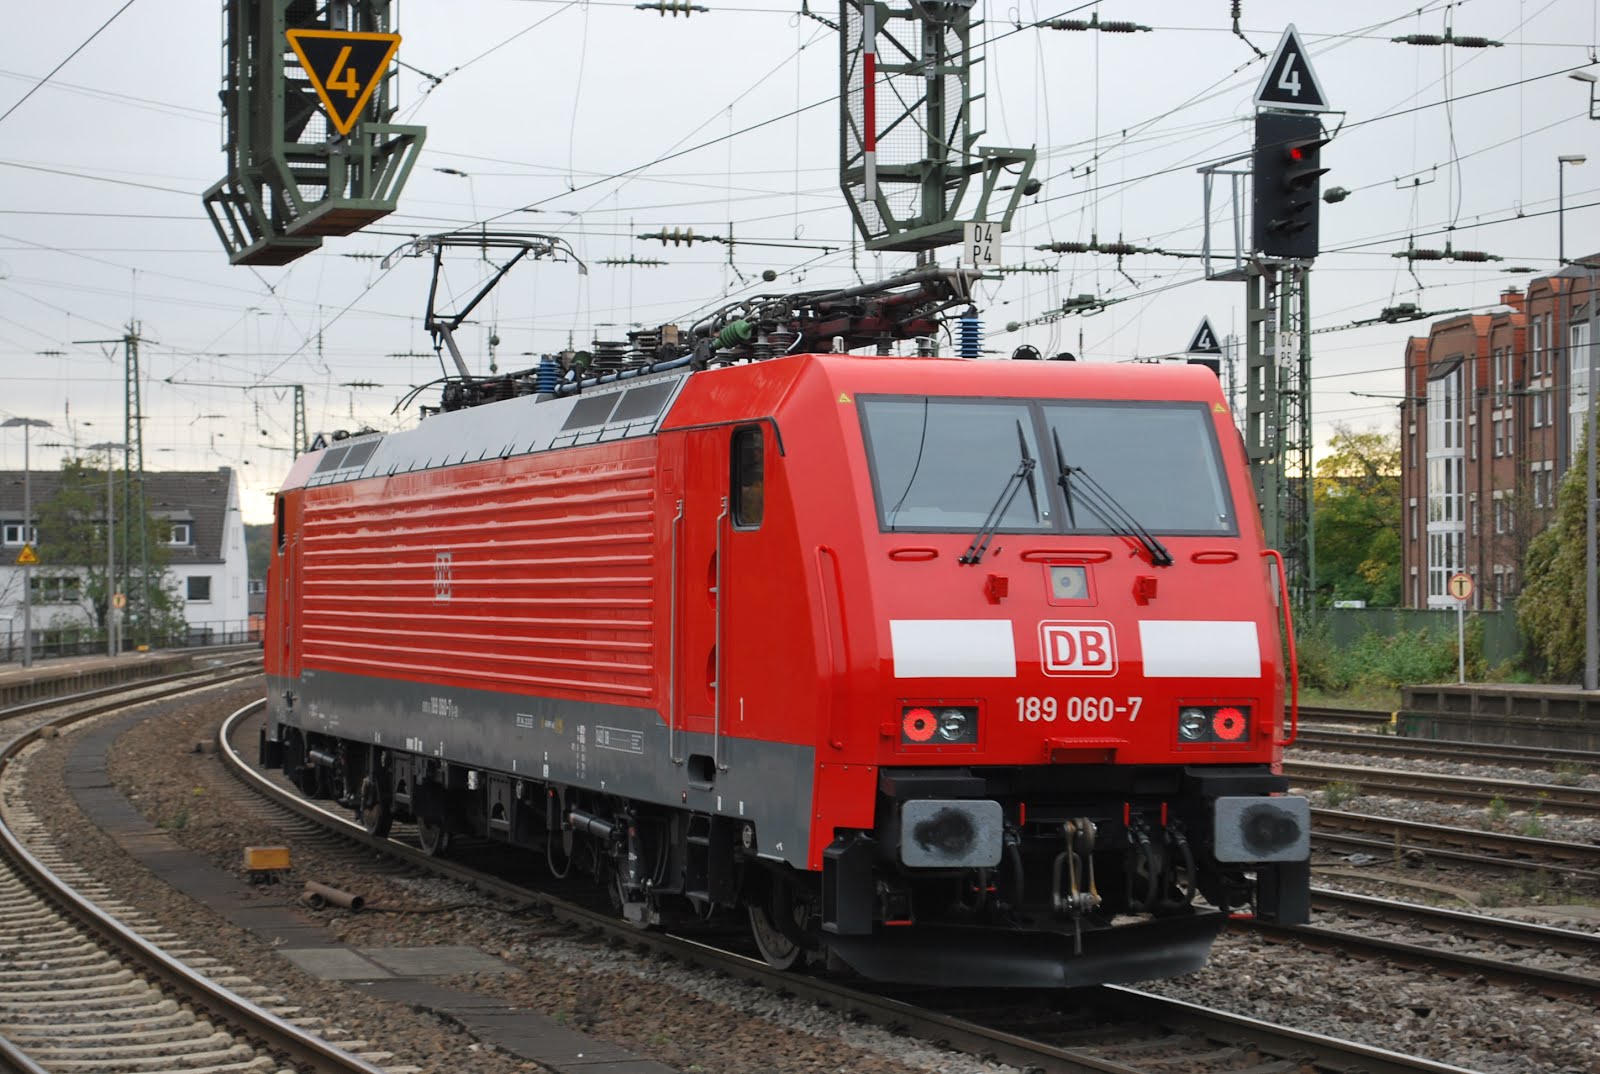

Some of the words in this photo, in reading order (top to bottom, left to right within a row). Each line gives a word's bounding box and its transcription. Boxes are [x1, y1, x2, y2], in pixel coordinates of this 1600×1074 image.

[326, 46, 360, 98] 4
[1278, 52, 1302, 97] 4
[973, 245, 992, 263] P4
[1198, 328, 1212, 350] 4
[1048, 630, 1108, 666] DB
[1015, 696, 1058, 722] 189
[1066, 696, 1143, 722] 060-7
